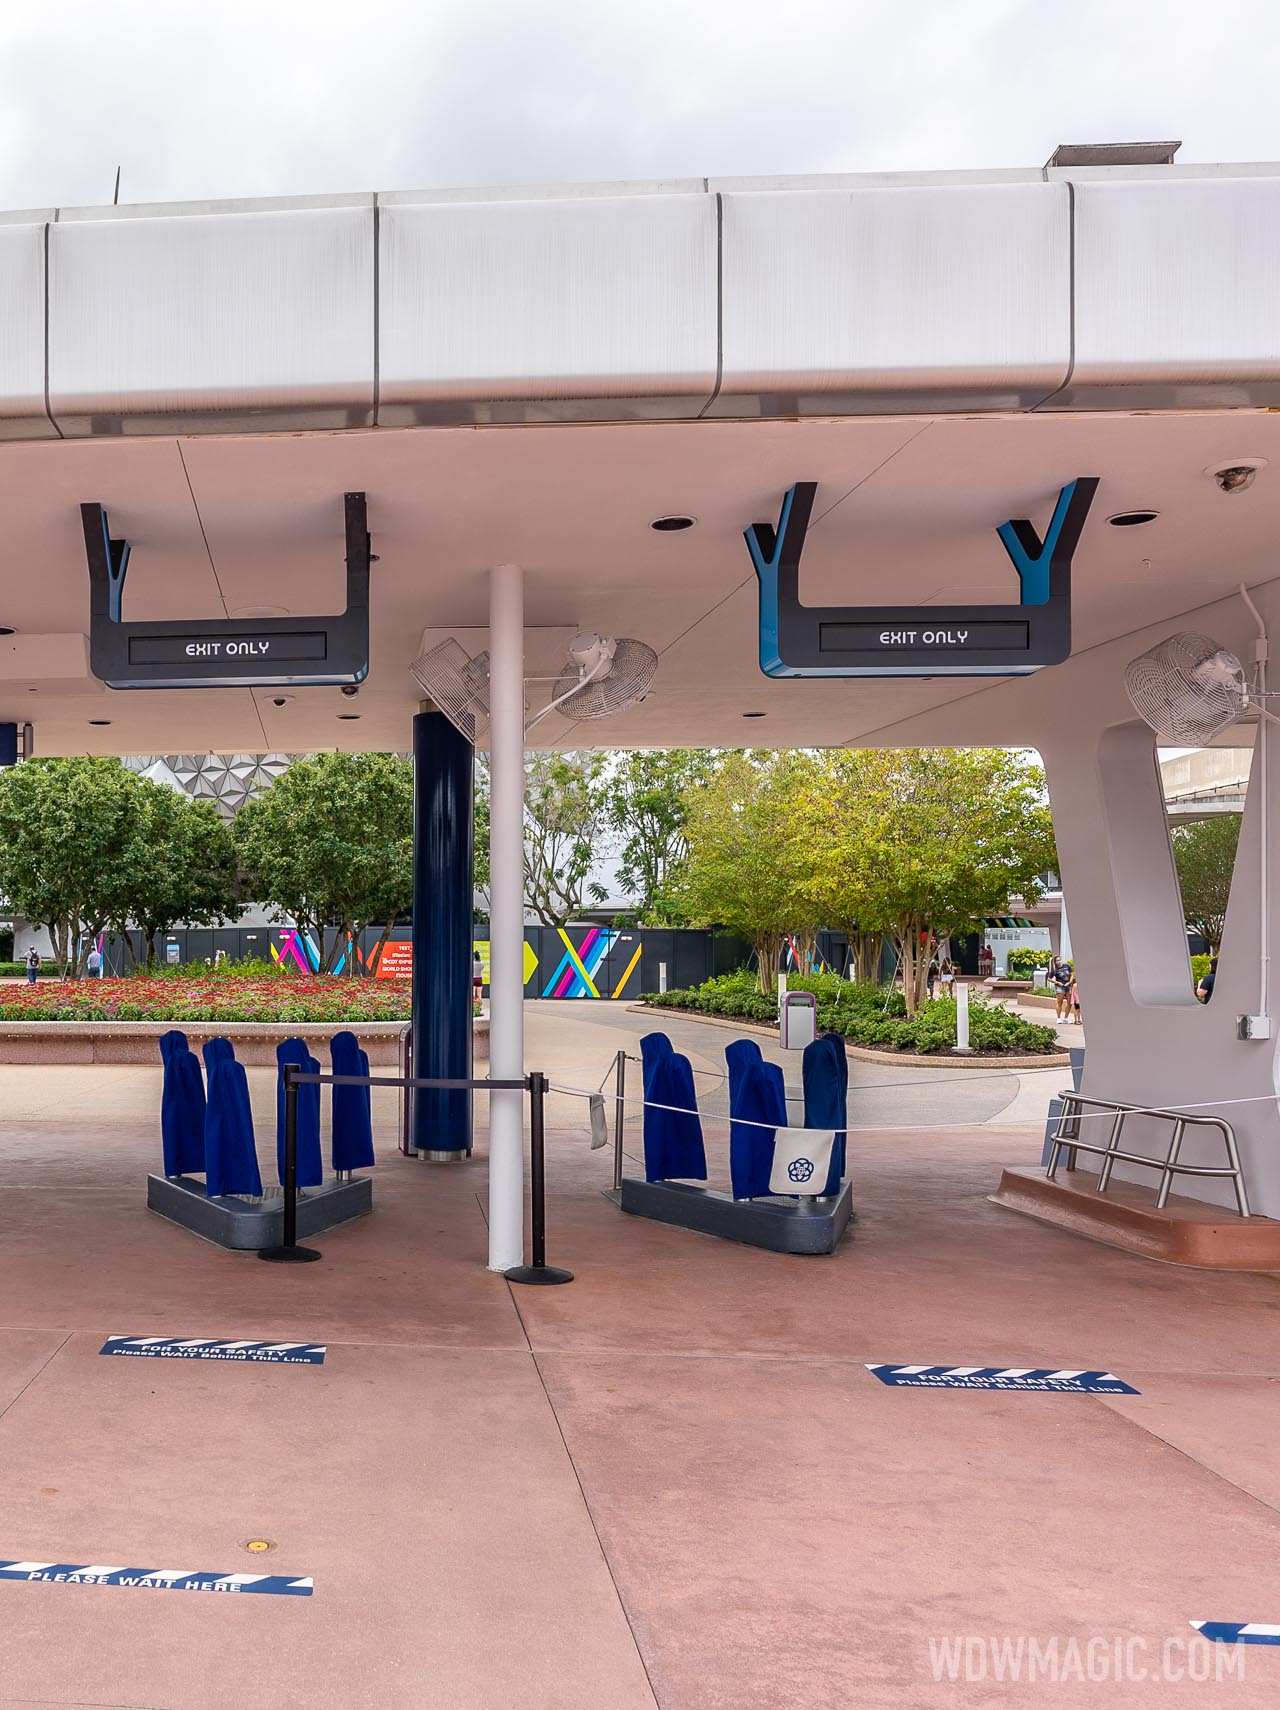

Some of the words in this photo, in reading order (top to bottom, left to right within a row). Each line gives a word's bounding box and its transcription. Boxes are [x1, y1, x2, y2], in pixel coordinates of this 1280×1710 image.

[879, 631, 917, 644] EXIT
[922, 630, 968, 644] ONLY
[185, 643, 221, 656] EXIT
[226, 641, 270, 655] ONLY
[1011, 1378, 1082, 1386] SAFETY
[27, 1572, 110, 1585] PLEASE
[118, 1576, 176, 1588] WAIT
[185, 1580, 241, 1592] HERE
